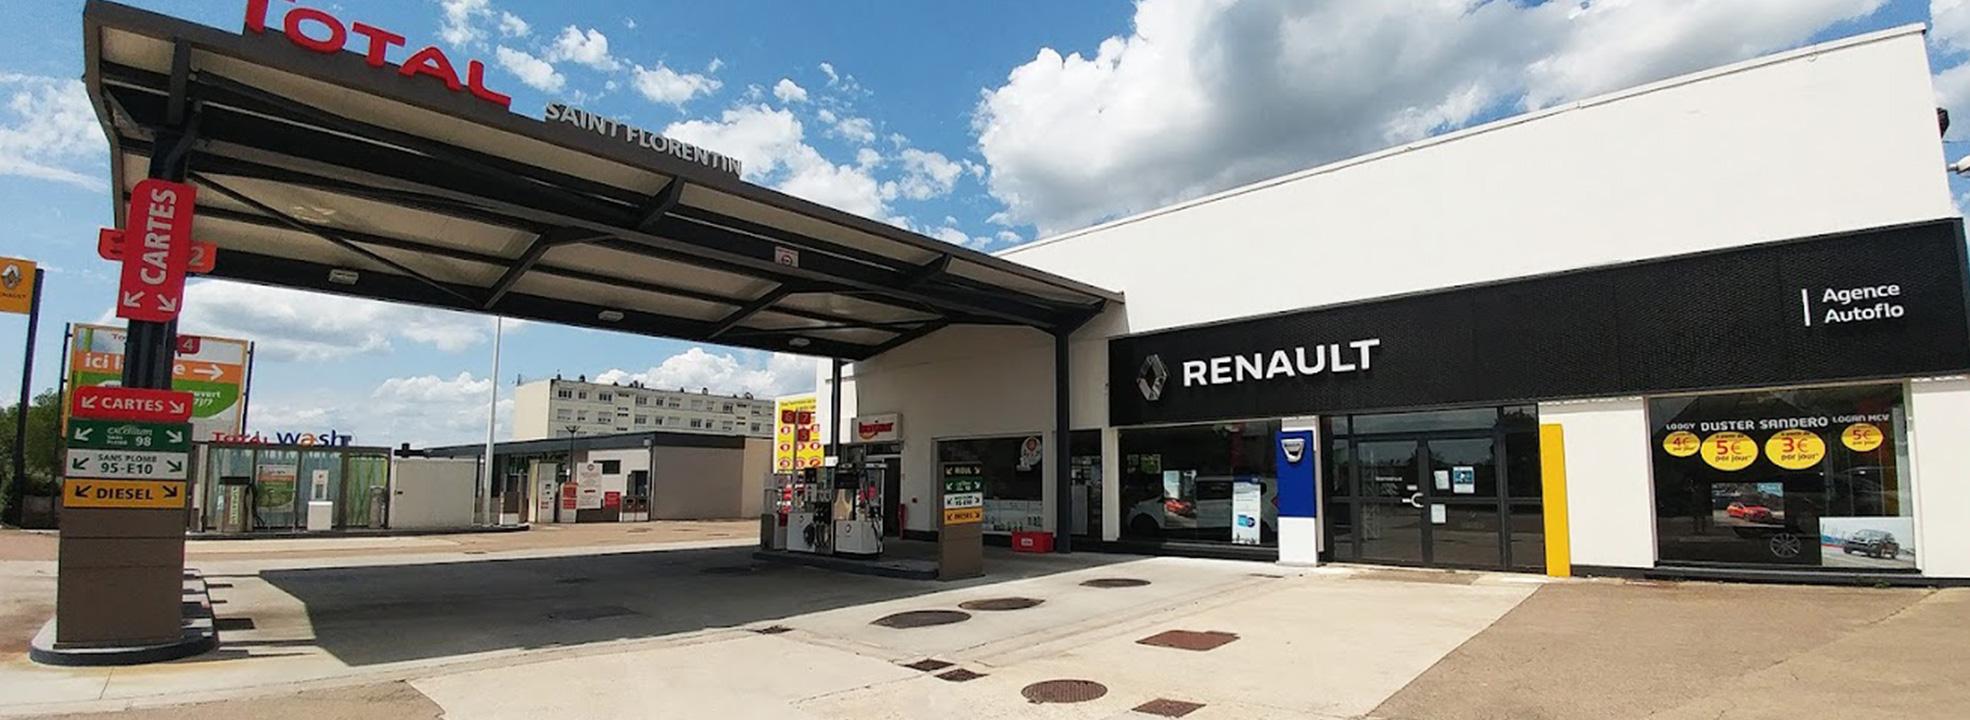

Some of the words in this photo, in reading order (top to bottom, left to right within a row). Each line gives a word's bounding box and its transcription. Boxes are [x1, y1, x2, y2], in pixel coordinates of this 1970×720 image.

[244, 0, 512, 109] TOTAL
[545, 102, 620, 137] SAINT
[626, 126, 743, 177] FLORENTIN
[140, 188, 177, 285] CARTES
[188, 246, 205, 266] 2
[1822, 284, 1901, 305] Agence
[1824, 303, 1905, 324] Autoflo
[182, 338, 195, 351] 4
[85, 353, 109, 368] ici
[1183, 338, 1381, 387] RENAULT
[101, 397, 164, 412] CARTES
[1700, 419, 1755, 432] DUSTER
[1759, 416, 1829, 430] SANDERO
[1832, 415, 1866, 424] LOGAN
[135, 435, 152, 447] 98
[276, 429, 350, 448] wash
[1852, 429, 1871, 440] 5€
[1716, 439, 1743, 456] 5€
[1782, 436, 1808, 453] 3€
[98, 453, 121, 461] SANS
[125, 455, 157, 463] PLOMB
[100, 461, 153, 474] 95-E10
[96, 487, 154, 500] DIESEL
